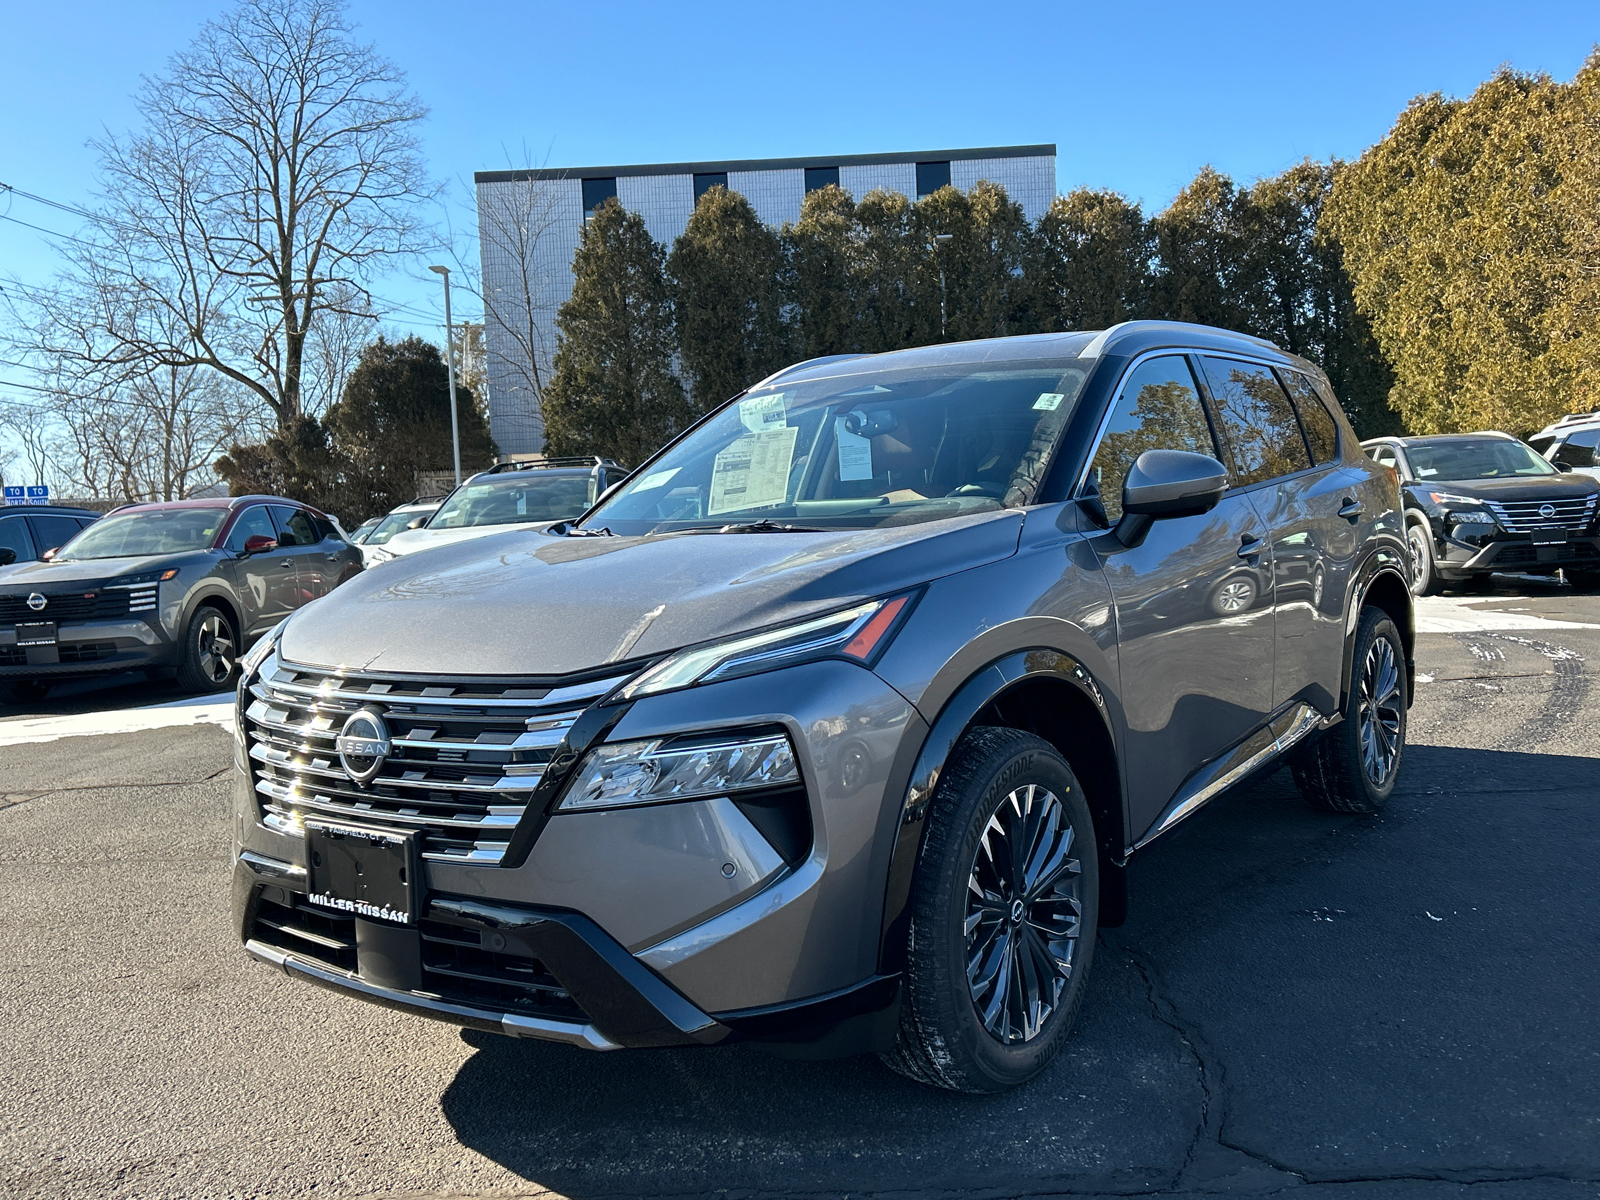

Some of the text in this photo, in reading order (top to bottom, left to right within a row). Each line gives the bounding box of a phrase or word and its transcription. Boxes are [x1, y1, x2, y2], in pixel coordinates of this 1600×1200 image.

[10, 488, 21, 496] TO
[33, 488, 44, 496] TO
[6, 498, 26, 506] NORTH
[28, 498, 48, 506] SOUTH
[966, 754, 1034, 849] BRIDGESTONE
[308, 893, 409, 923] MILLER NISSAN
